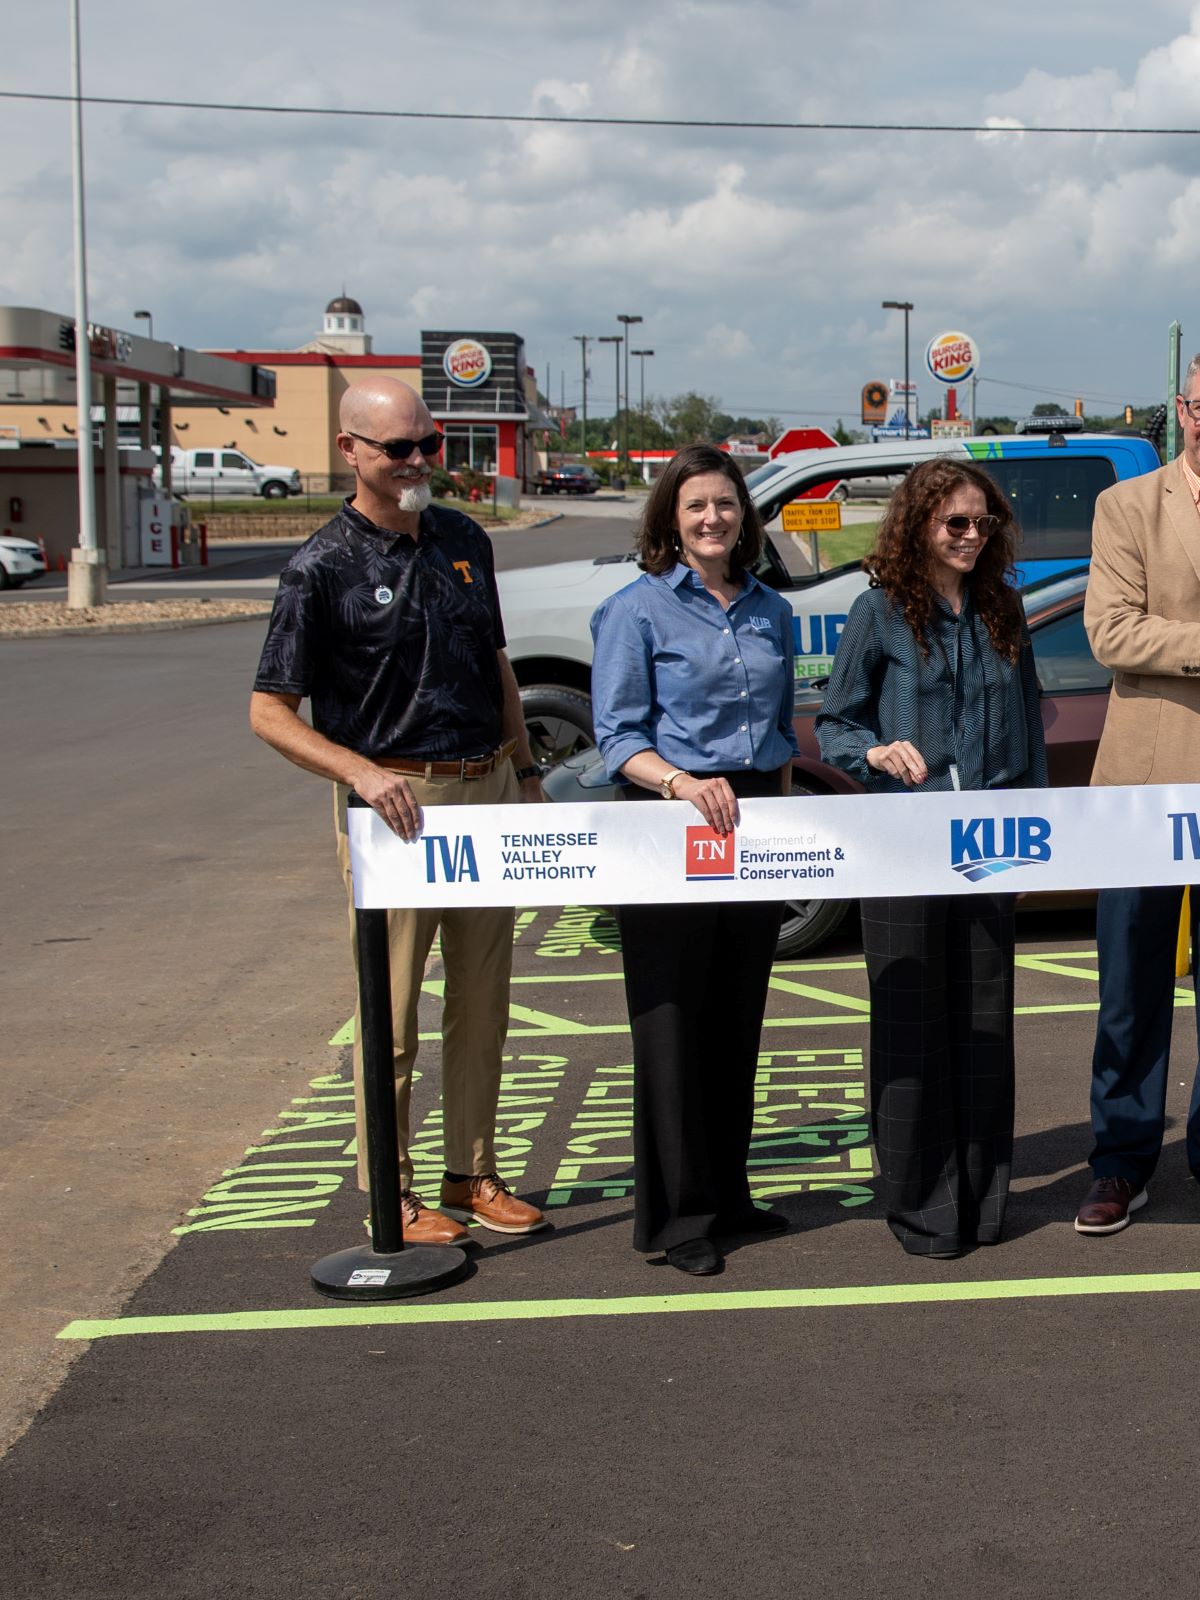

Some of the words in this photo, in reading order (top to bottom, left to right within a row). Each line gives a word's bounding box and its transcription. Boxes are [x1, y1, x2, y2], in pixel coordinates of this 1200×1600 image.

[931, 341, 970, 359] BURGER
[452, 360, 485, 375] KING
[933, 350, 972, 372] KING
[785, 508, 805, 516] TRAFFIC
[825, 507, 837, 515] LEFT
[150, 503, 163, 553] ICE
[453, 560, 473, 583] T
[501, 832, 598, 847] TENNESSEE
[740, 834, 804, 848] Department
[807, 833, 817, 845] of
[950, 816, 1051, 865] KUB
[501, 850, 562, 864] VALLEY
[693, 839, 727, 860] TN
[740, 848, 831, 863] Environment
[834, 847, 845, 860] &
[420, 835, 480, 883] TVA
[502, 865, 597, 880] AUTHORITY
[740, 865, 834, 880] Conservation
